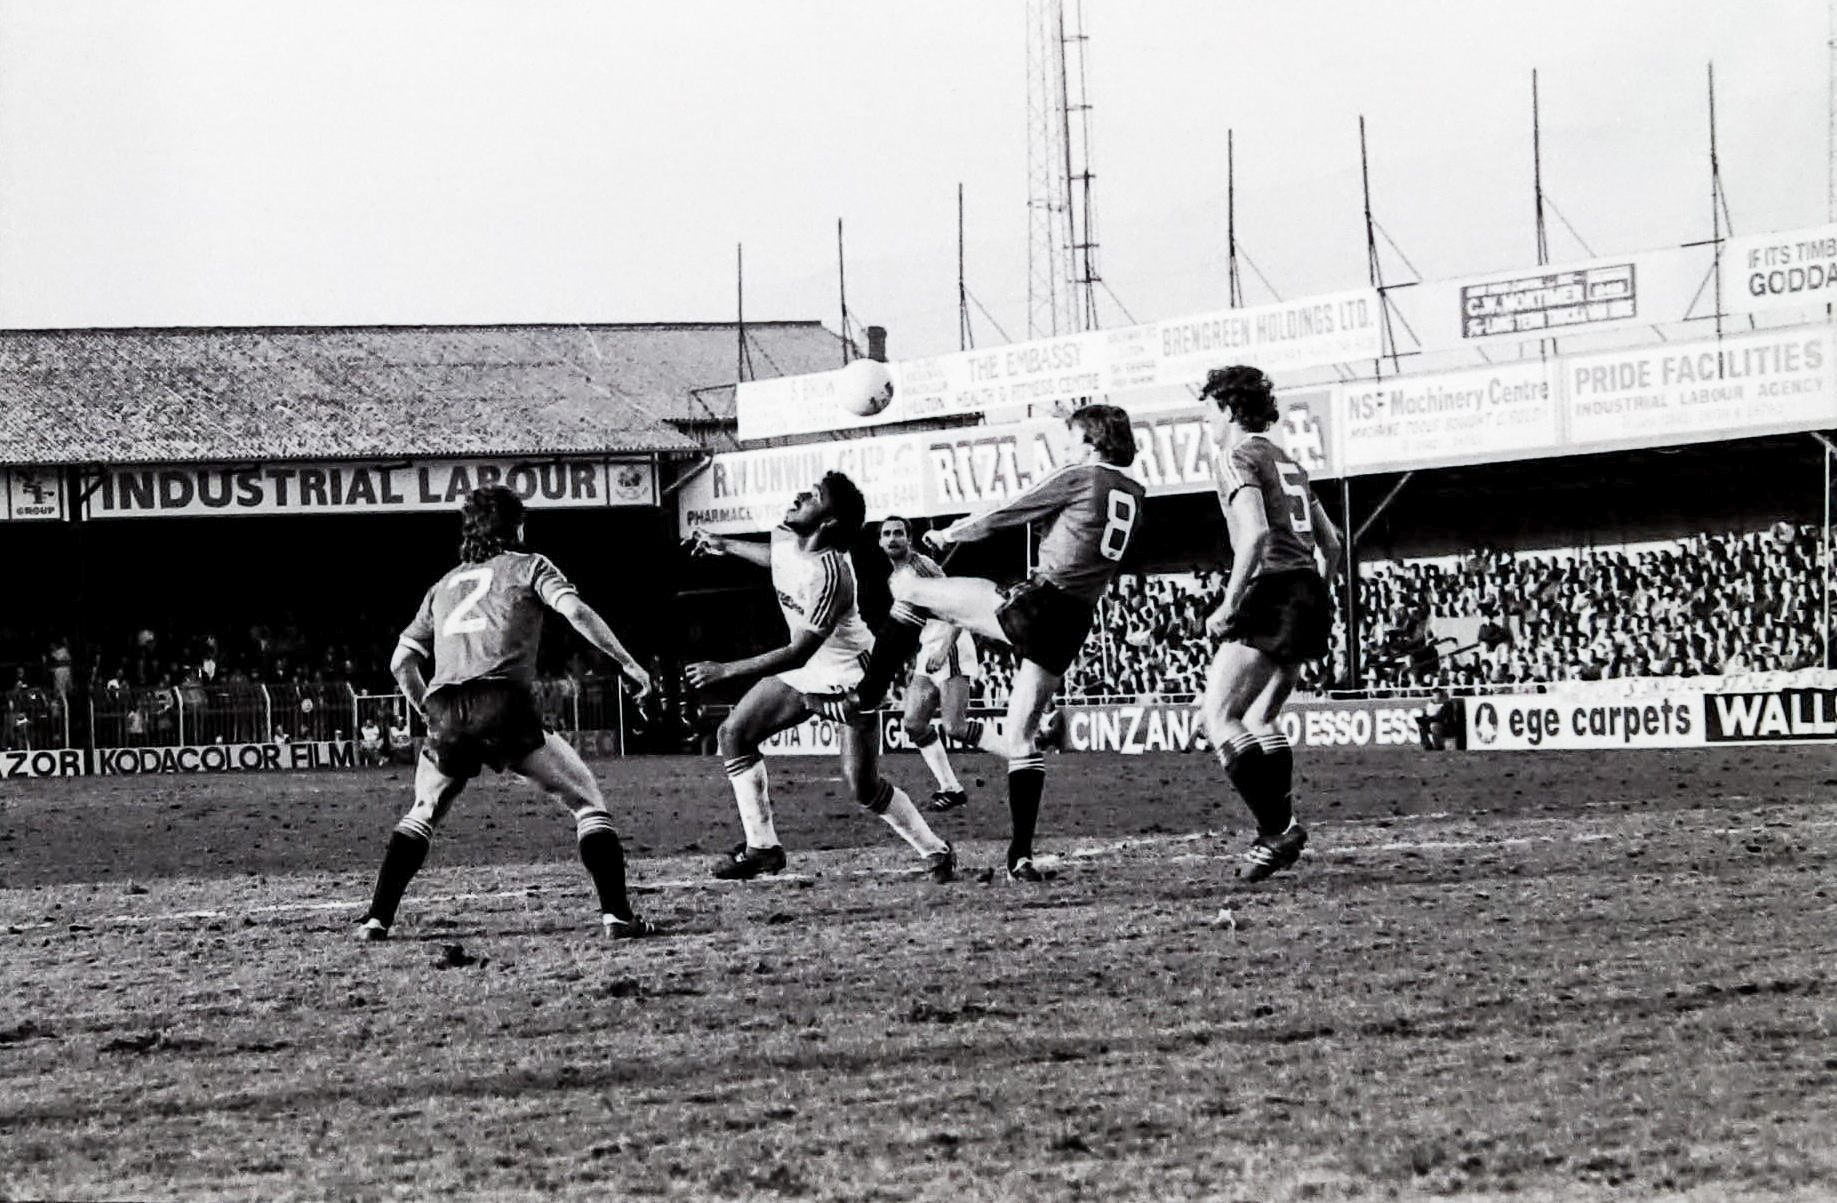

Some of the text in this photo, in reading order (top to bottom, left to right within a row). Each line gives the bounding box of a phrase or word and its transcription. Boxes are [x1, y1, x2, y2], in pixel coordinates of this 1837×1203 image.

[1256, 303, 1335, 344] HOLDINGS
[968, 354, 999, 383] THE
[1006, 341, 1082, 377] EMBASSY
[1574, 339, 1824, 396] PRIDE FACILITIES
[1390, 384, 1484, 417] Machinery
[1488, 376, 1550, 406] Centre
[1575, 376, 1824, 417] INDUSTRIAL LABOUR AGENCY
[102, 465, 404, 511] INDUSTRIAL
[1273, 460, 1312, 533] 5
[16, 506, 56, 517] GROUP
[1100, 489, 1136, 562] 8
[443, 567, 495, 638] 2
[1305, 708, 1373, 747] ESSO
[1509, 697, 1691, 746] ege carpets
[1714, 692, 1837, 737] WALL
[0, 750, 81, 778] ZOR
[100, 740, 352, 777] KODACOLOR FILM
